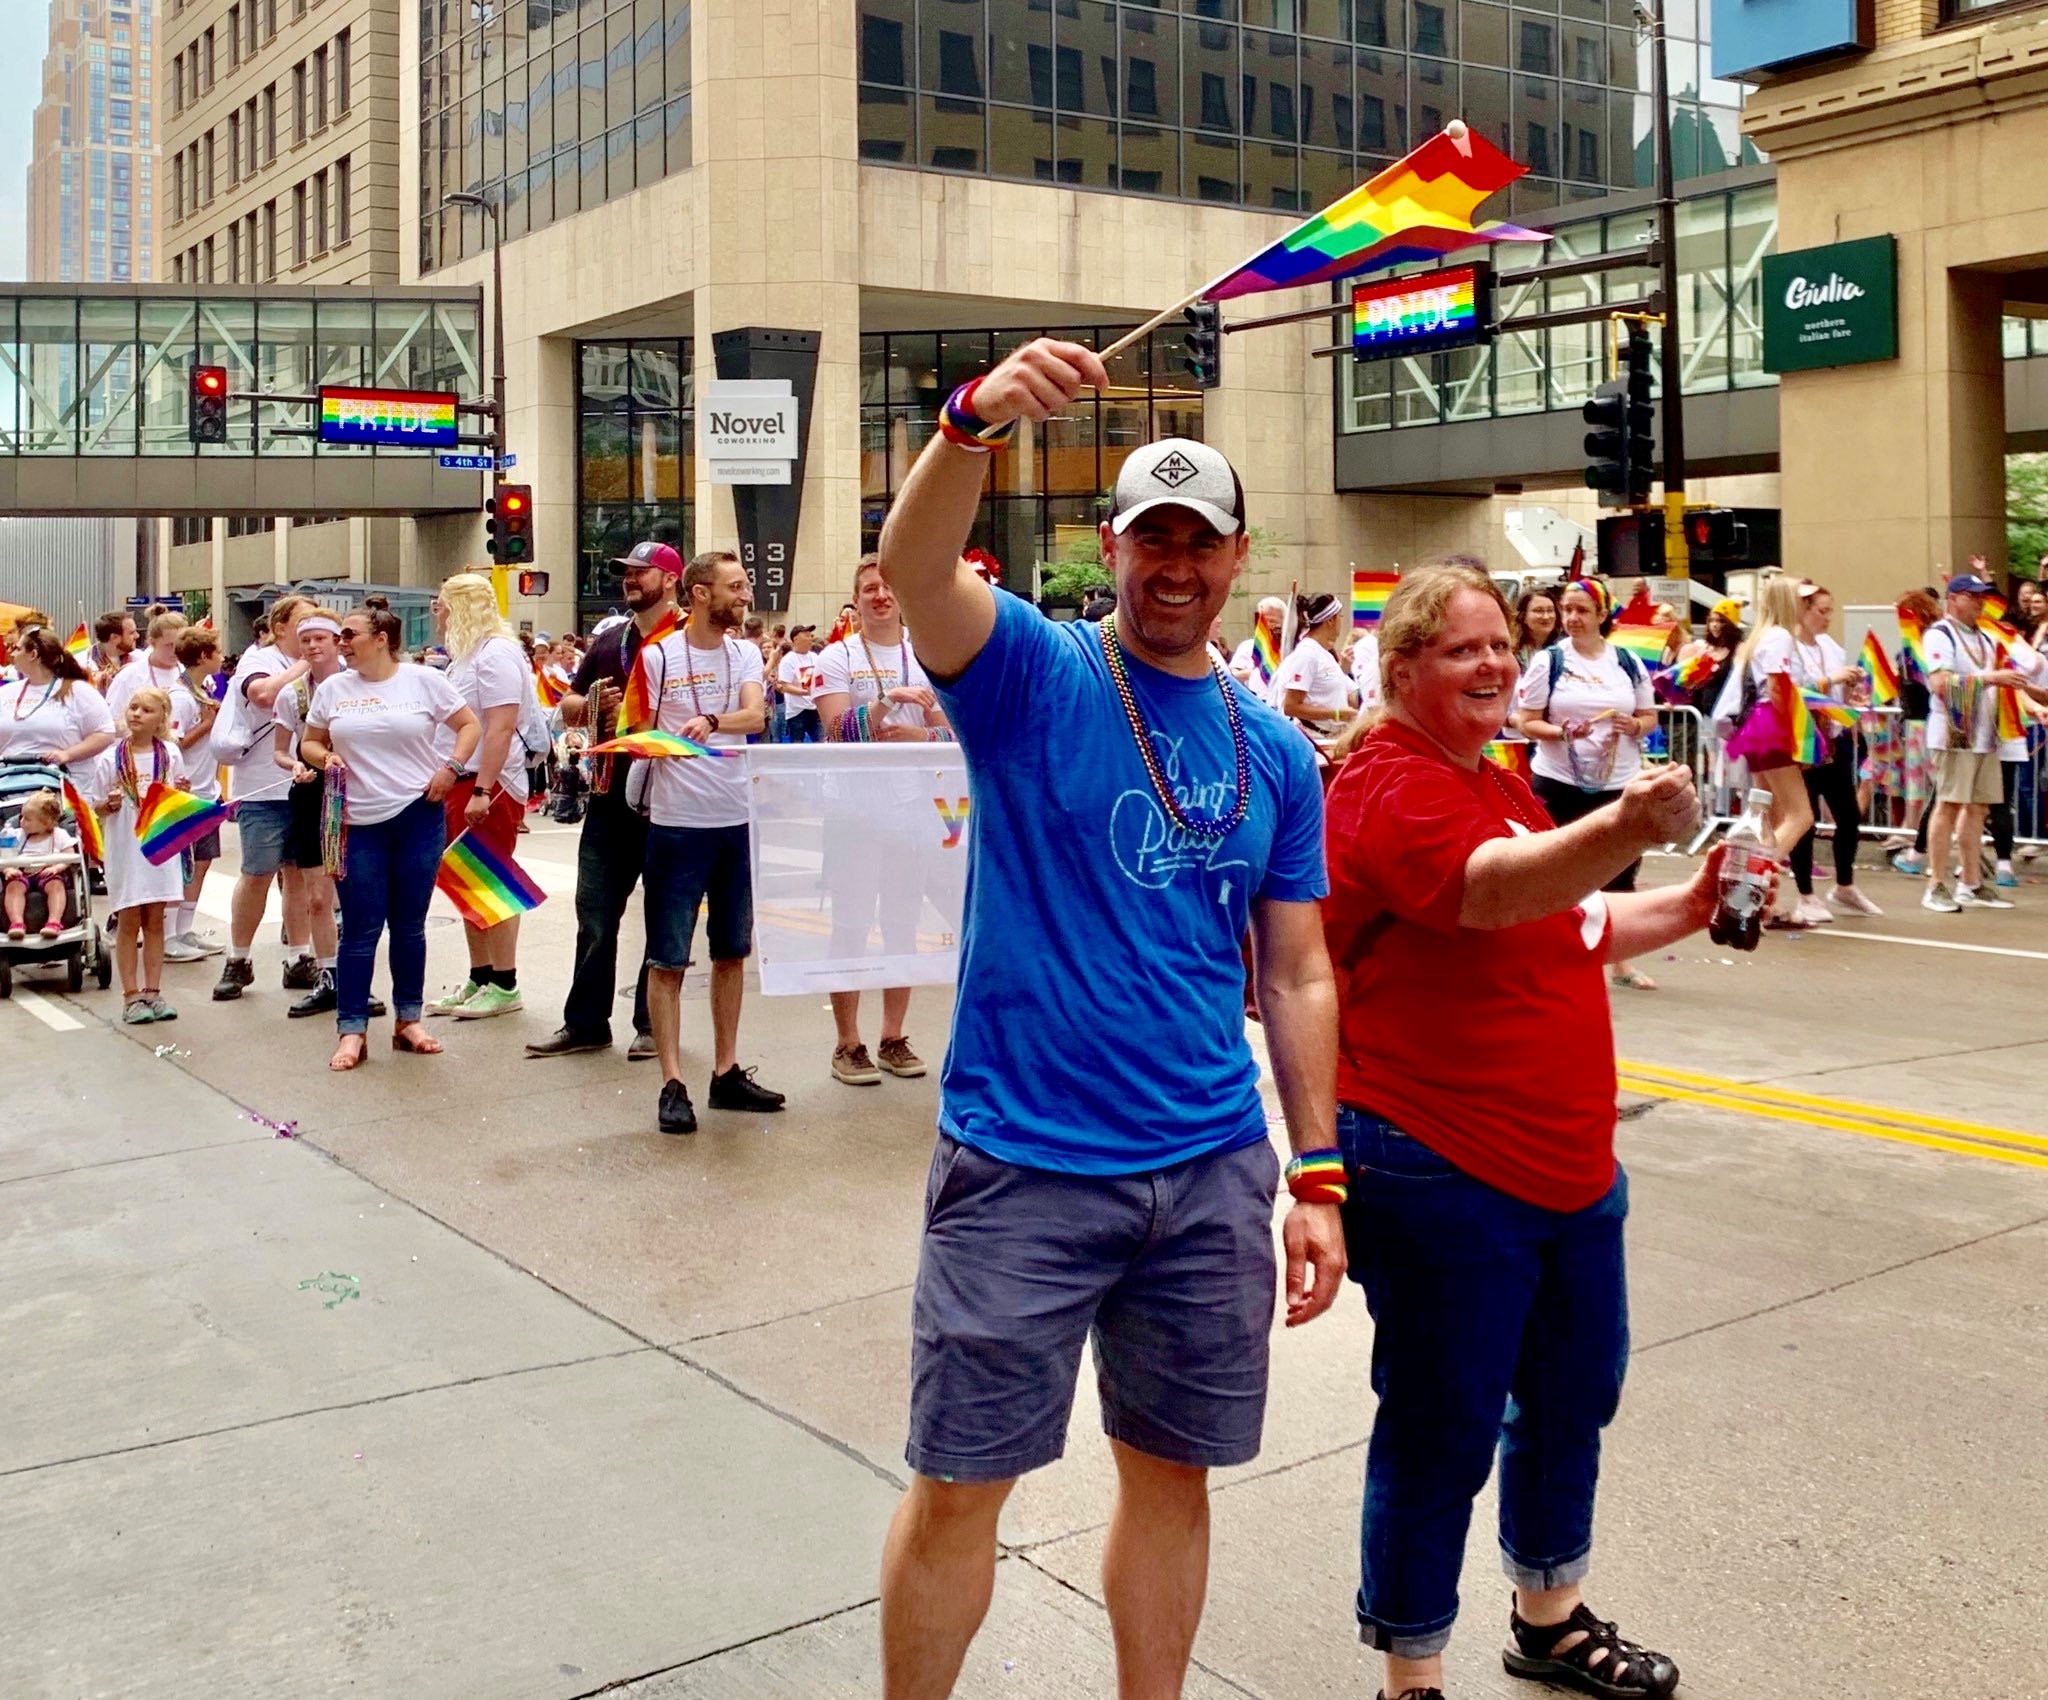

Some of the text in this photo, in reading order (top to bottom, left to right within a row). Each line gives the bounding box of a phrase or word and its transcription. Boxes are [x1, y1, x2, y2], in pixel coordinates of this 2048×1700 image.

[1785, 272, 1865, 309] Giulia
[1368, 285, 1460, 341] PRIDE
[1804, 319, 1845, 331] northern
[1799, 328, 1852, 342] italian fare
[338, 398, 438, 433] PRIDE
[710, 412, 785, 434] Novel
[444, 457, 488, 467] S 4th St
[717, 467, 781, 477] novelcoworking.com
